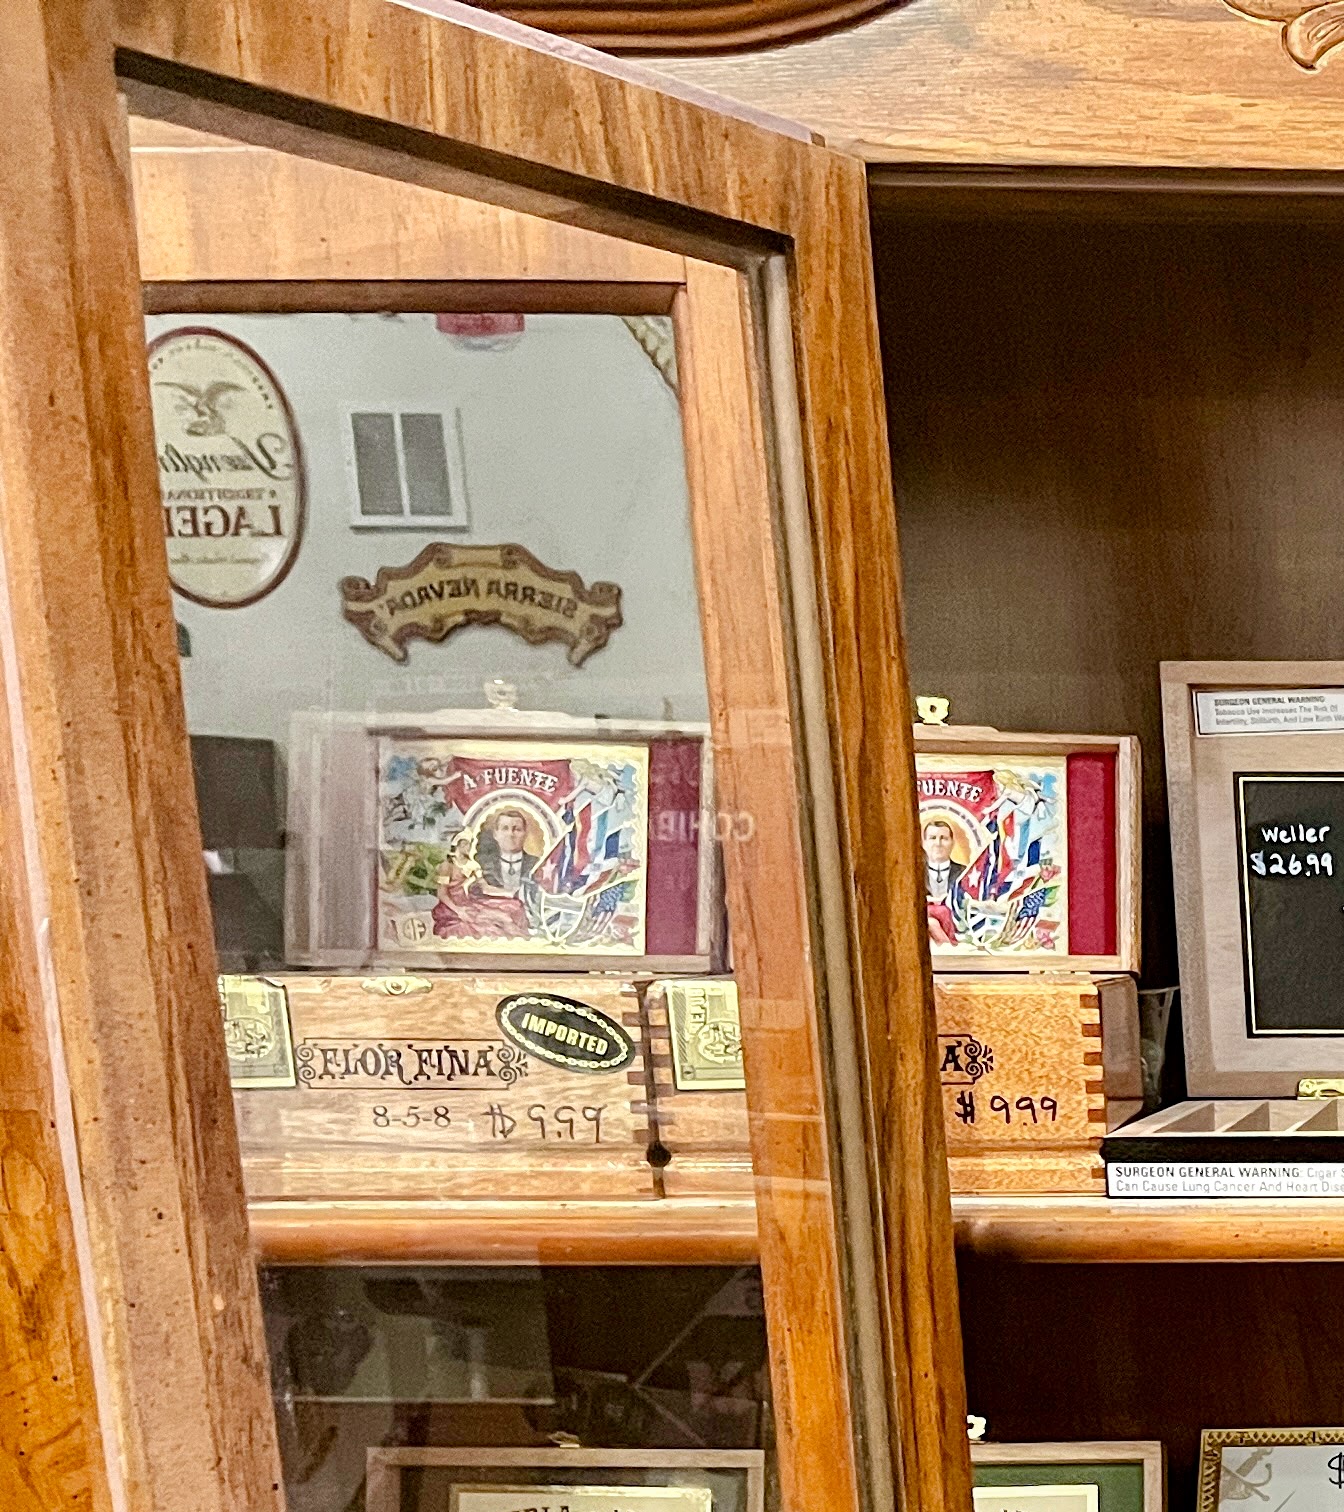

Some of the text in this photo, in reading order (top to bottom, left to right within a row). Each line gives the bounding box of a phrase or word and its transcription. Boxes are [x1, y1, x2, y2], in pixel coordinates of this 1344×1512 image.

[483, 767, 559, 794] FUENTE
[1261, 824, 1332, 844] Weller
[1250, 851, 1335, 877] $26.99
[522, 1010, 609, 1057] IMPORTED
[416, 1044, 500, 1081] FINA
[373, 1105, 452, 1129] 8-5-8
[1115, 1166, 1175, 1179] SURGEON
[1179, 1166, 1235, 1178] GENERAL
[1307, 1167, 1336, 1180] Cigar
[1116, 1182, 1139, 1193] Can
[1142, 1182, 1179, 1193] Cause
[1182, 1181, 1210, 1195] Lung
[1214, 1181, 1255, 1193] Cancer
[1259, 1181, 1282, 1192] And
